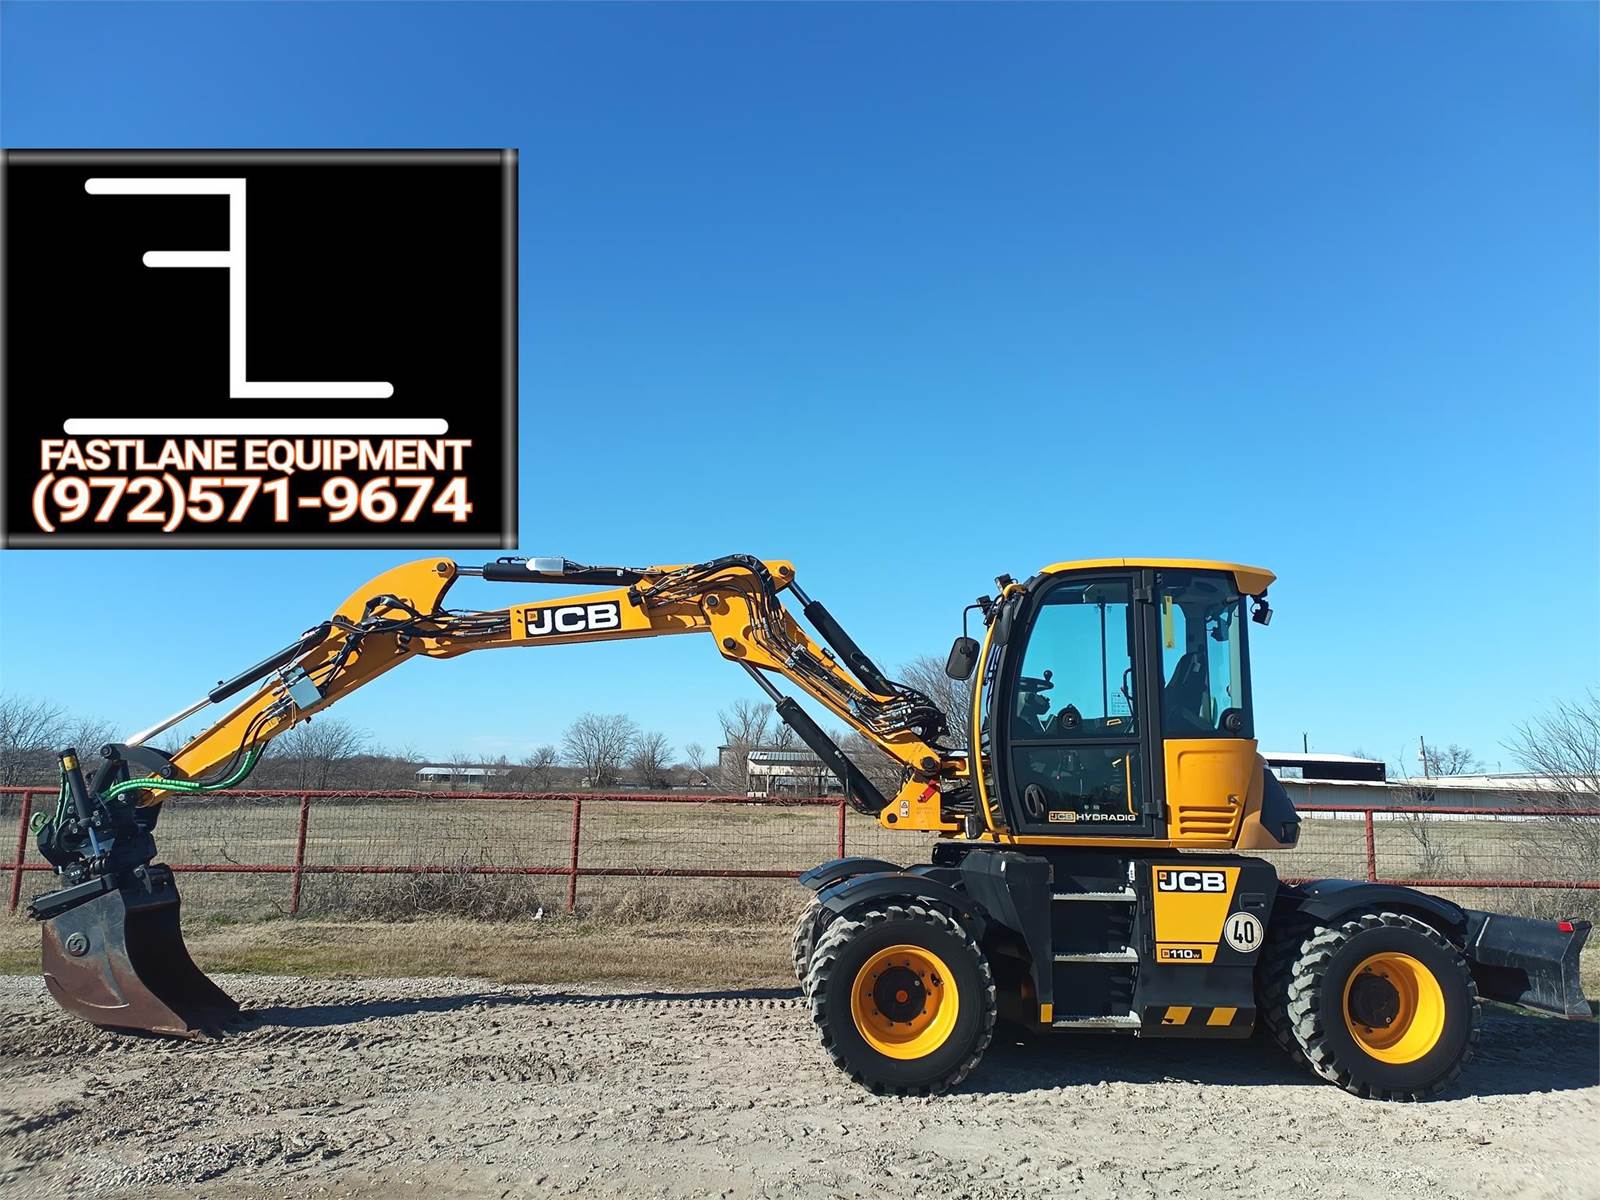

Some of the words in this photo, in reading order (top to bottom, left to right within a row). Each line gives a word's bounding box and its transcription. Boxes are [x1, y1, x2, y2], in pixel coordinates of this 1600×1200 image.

[527, 603, 619, 635] JCB
[1050, 812, 1075, 821] JCB
[1076, 813, 1136, 821] HYDRADIG
[1158, 871, 1226, 892] JCB
[1233, 920, 1254, 944] 40
